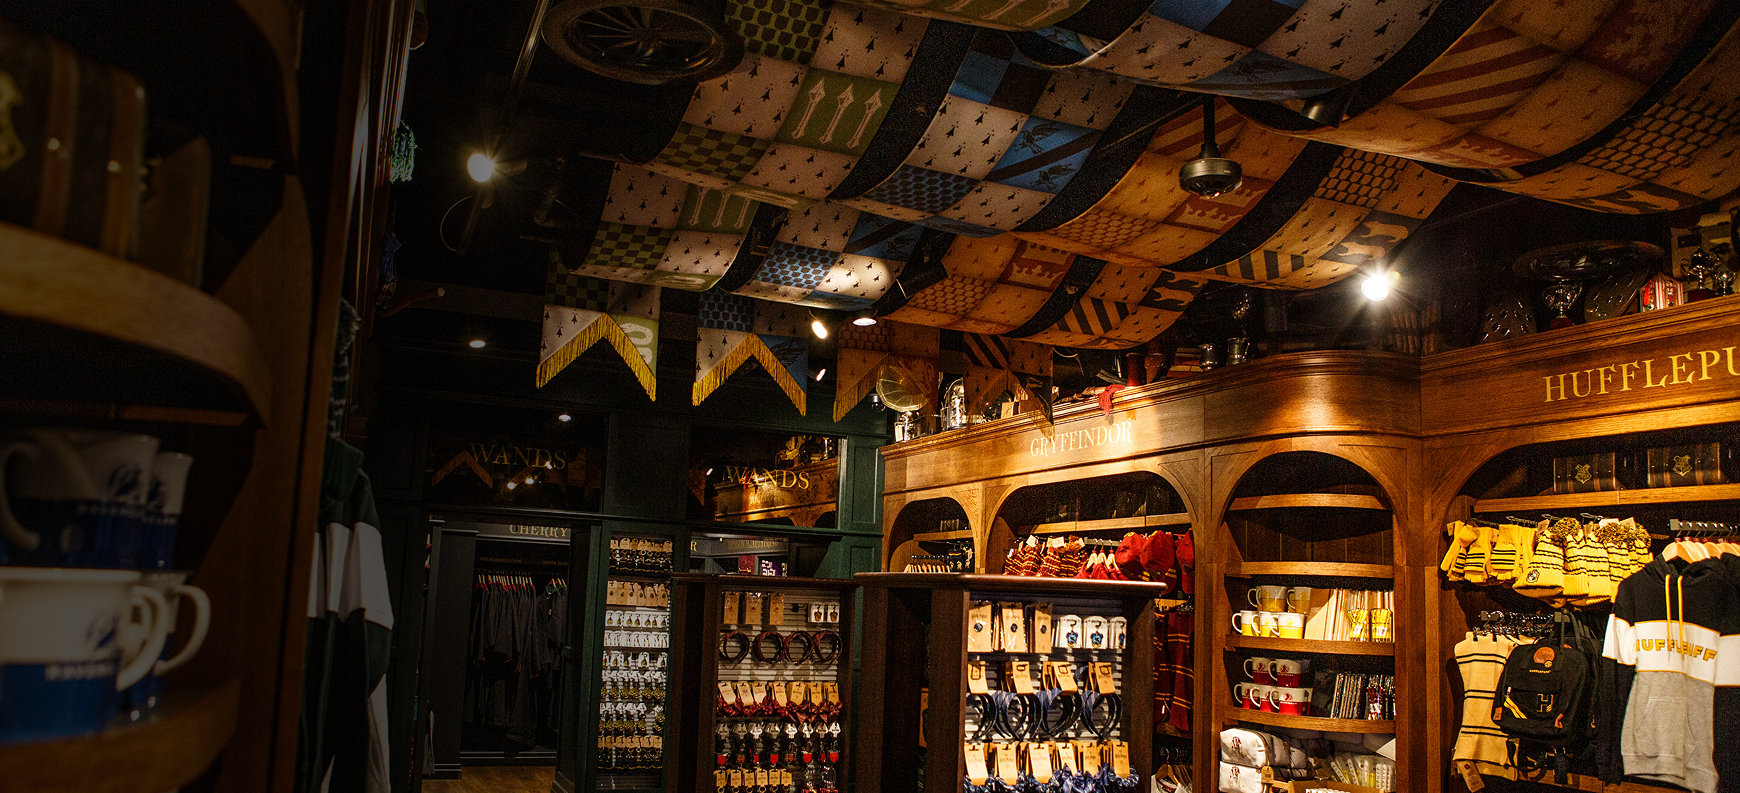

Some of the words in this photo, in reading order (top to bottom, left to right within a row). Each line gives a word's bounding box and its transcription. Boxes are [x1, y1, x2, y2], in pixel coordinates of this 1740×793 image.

[1542, 345, 1740, 403] HUFFLEPU
[1029, 420, 1134, 458] GRYFFINDOR
[467, 442, 567, 470] WANDS
[724, 464, 810, 490] WANDS
[509, 524, 568, 538] CHERRY
[1635, 638, 1719, 662] UFFLEUFF
